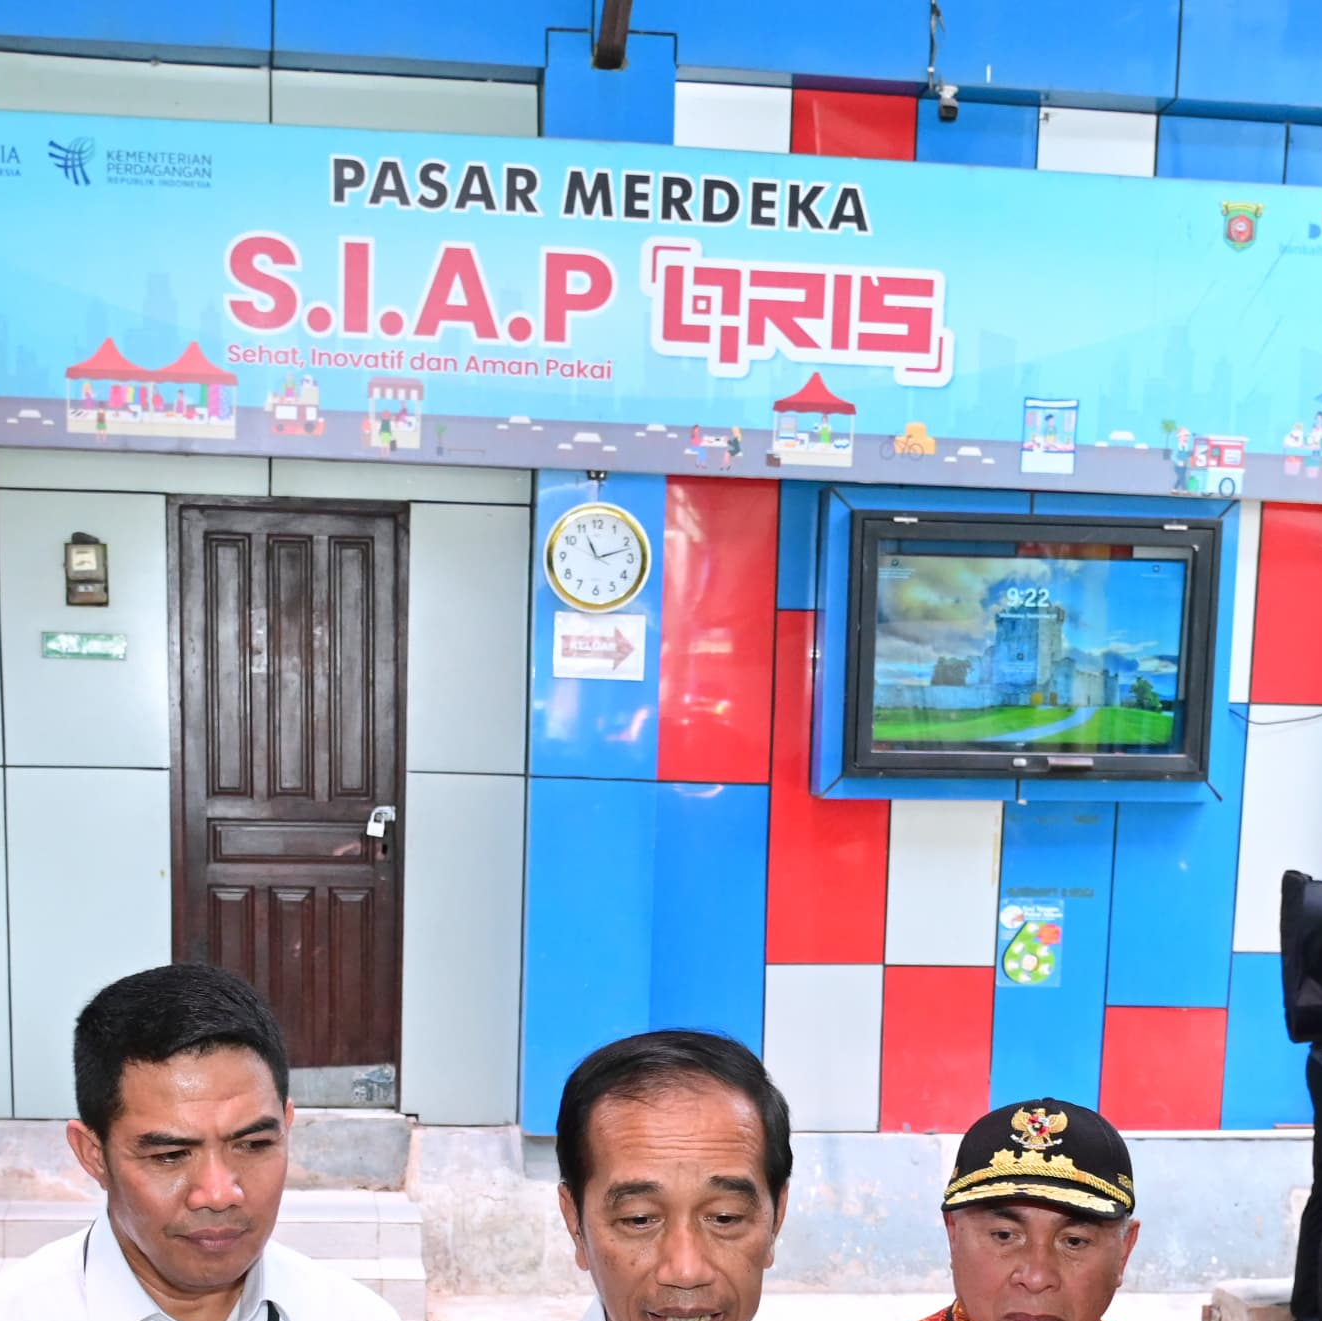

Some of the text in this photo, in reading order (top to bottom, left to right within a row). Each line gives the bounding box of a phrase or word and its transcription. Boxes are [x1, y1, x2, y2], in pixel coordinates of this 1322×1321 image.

[106, 149, 213, 166] KEMENTERIAN
[106, 162, 213, 179] PERDAGANGAN
[332, 158, 869, 233] PASAR MERDEKA
[228, 235, 936, 364] S.I.A.P QRIS
[227, 344, 613, 381] Sehat, Inovatif dan Aman Pakai
[577, 523, 587, 534] 11
[592, 519, 605, 530] 12
[612, 525, 617, 535] 1
[565, 535, 578, 546] 10
[623, 537, 631, 548] 2
[559, 551, 568, 562] 9
[626, 553, 635, 565] 3
[564, 568, 573, 580] 8
[620, 570, 629, 581] 4
[577, 579, 584, 590] 7
[609, 581, 617, 593] 5
[592, 585, 601, 597] 6
[1006, 587, 1050, 608] 9:22
